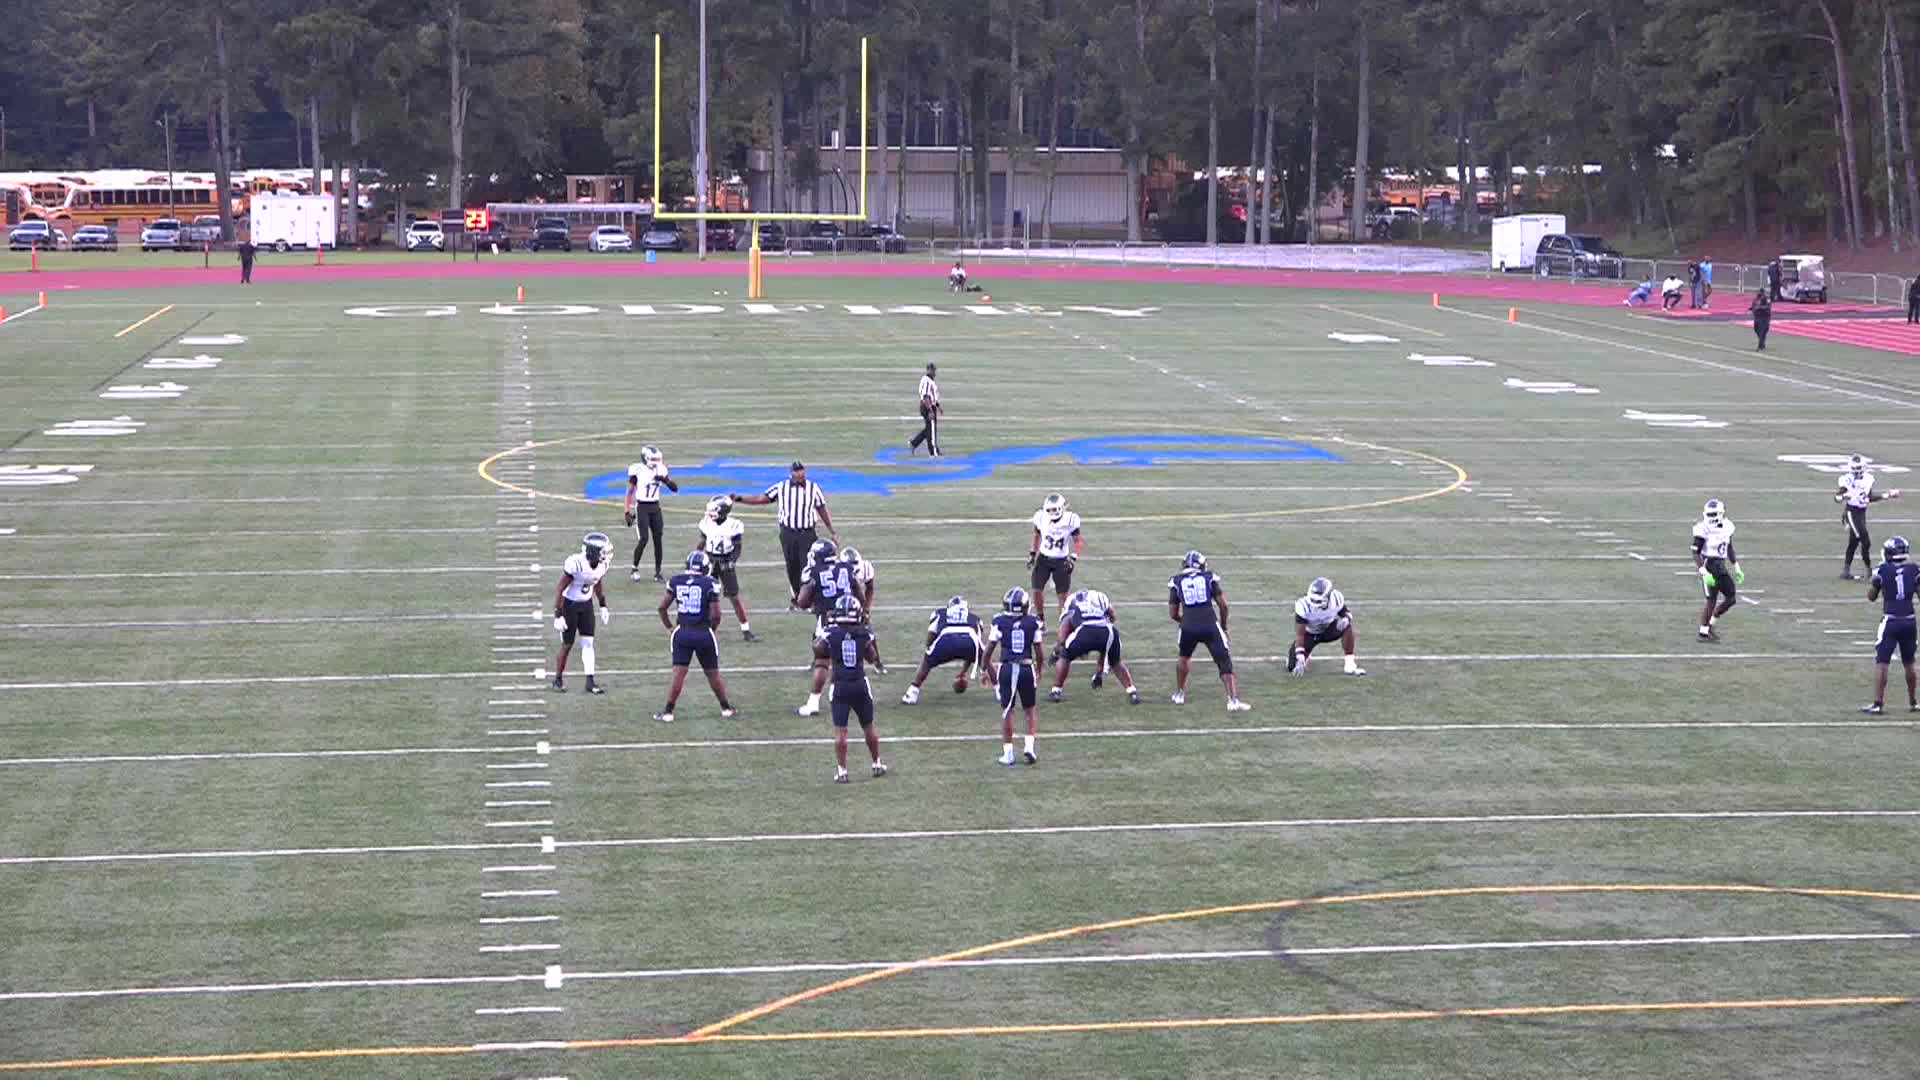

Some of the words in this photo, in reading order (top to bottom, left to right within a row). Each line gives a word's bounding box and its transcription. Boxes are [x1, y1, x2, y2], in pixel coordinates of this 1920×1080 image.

[645, 482, 660, 498] 17
[710, 540, 725, 555] 14
[1045, 535, 1065, 551] 34
[819, 567, 851, 598] 54
[1895, 574, 1905, 600] 1
[676, 584, 702, 614] 58
